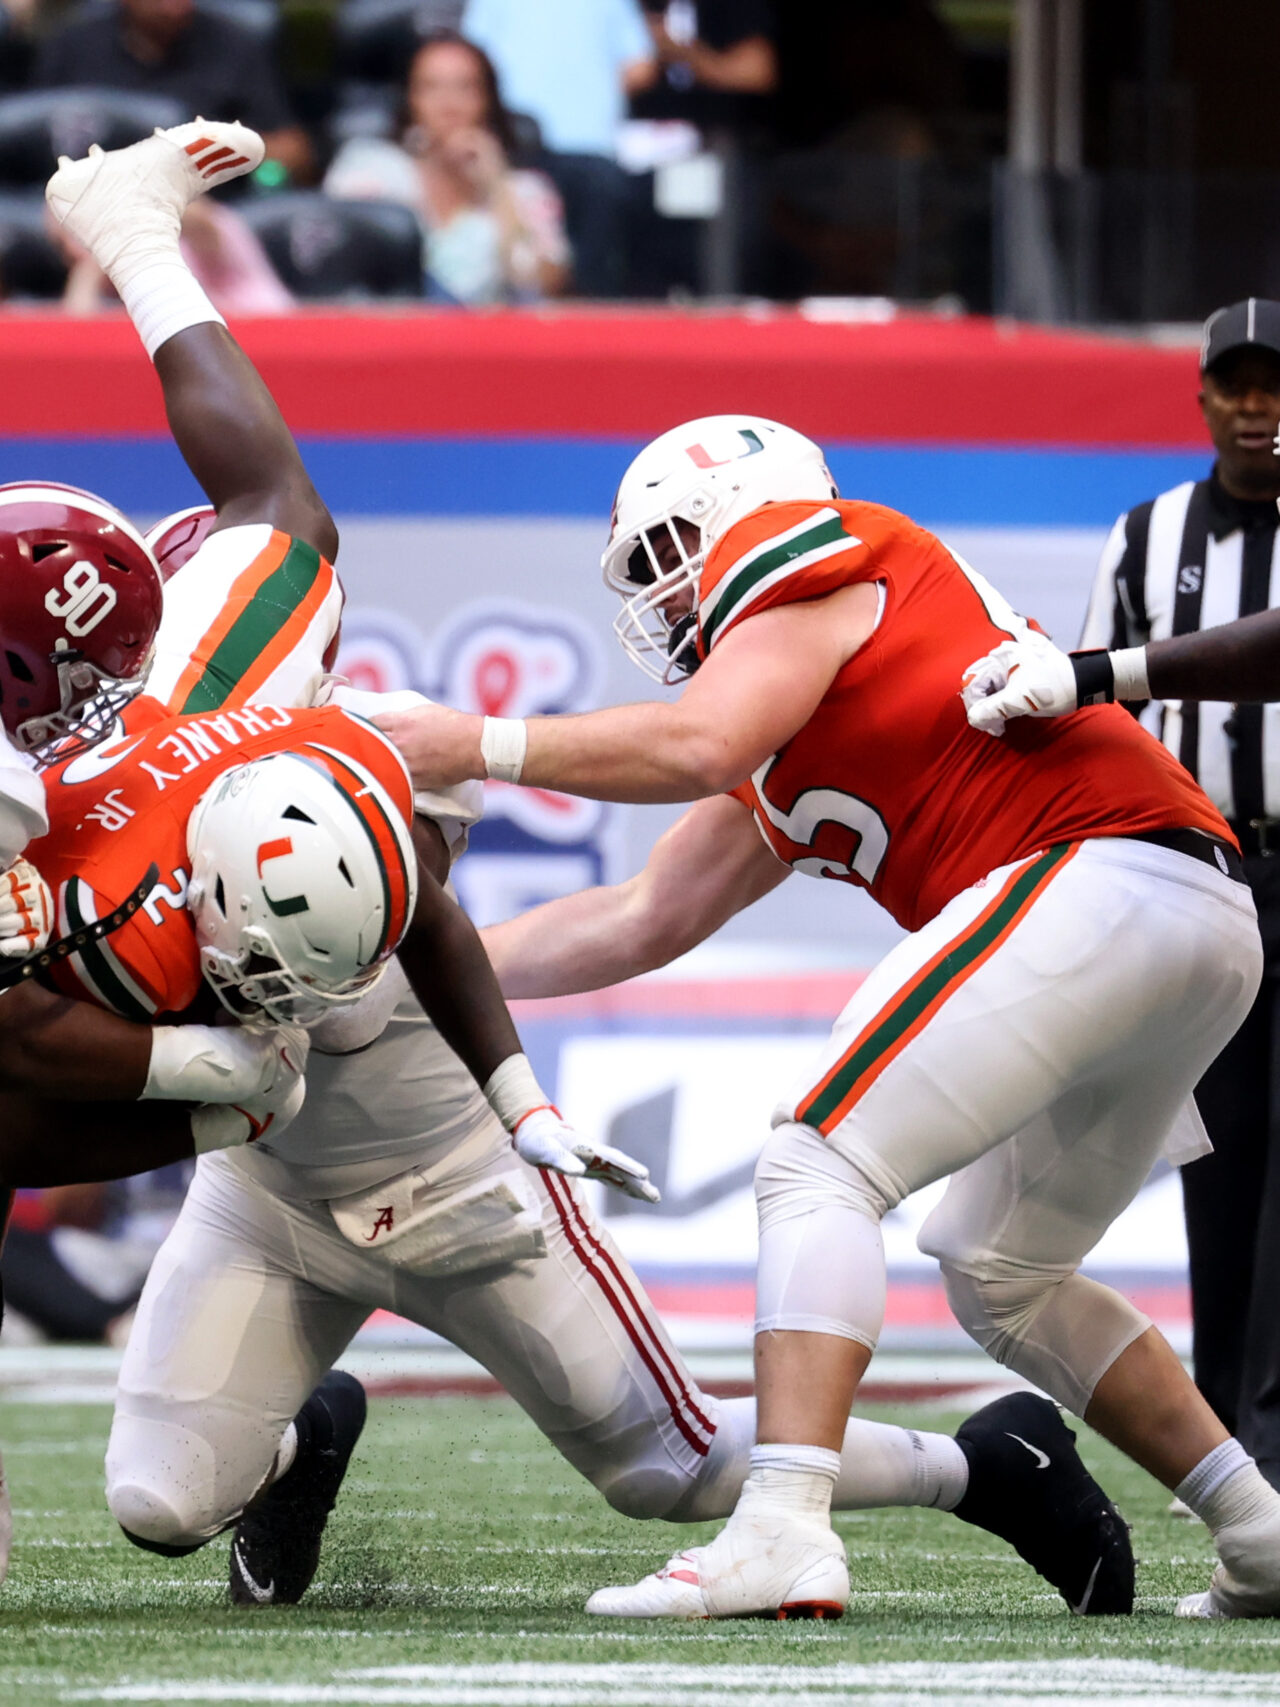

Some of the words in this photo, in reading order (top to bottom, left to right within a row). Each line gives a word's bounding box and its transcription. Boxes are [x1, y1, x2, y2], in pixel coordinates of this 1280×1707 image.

[684, 428, 765, 470] U
[44, 560, 117, 637] 90
[1178, 565, 1202, 594] S
[138, 702, 294, 792] CHANEY
[75, 788, 137, 832] JR.
[750, 753, 892, 886] 5
[141, 867, 190, 927] 2
[256, 836, 310, 918] U
[361, 1205, 394, 1242] A
